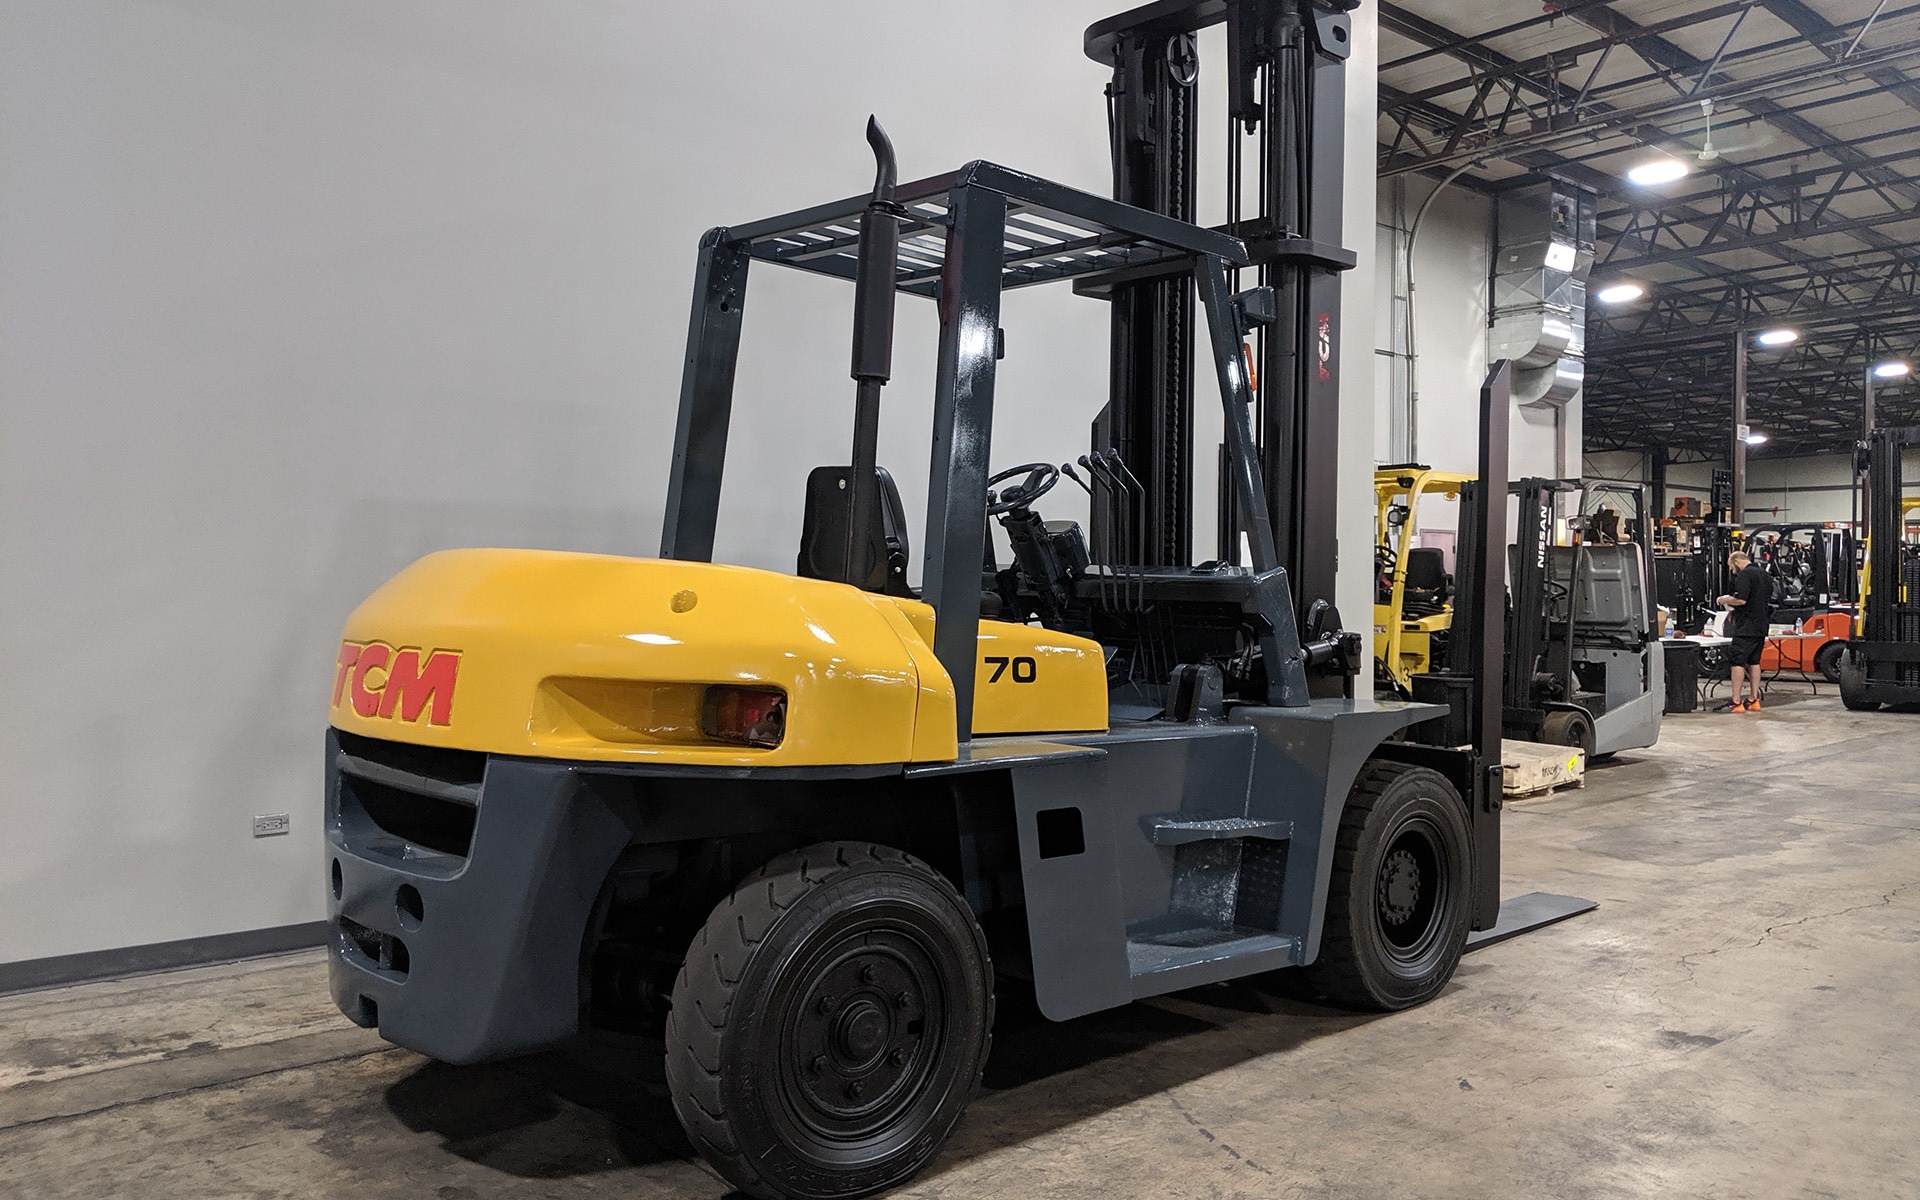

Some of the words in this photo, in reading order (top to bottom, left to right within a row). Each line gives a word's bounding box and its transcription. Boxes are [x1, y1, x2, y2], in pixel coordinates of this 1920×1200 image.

[1537, 506, 1548, 569] NISSAN
[332, 639, 463, 727] TCM
[984, 656, 1037, 684] 70
